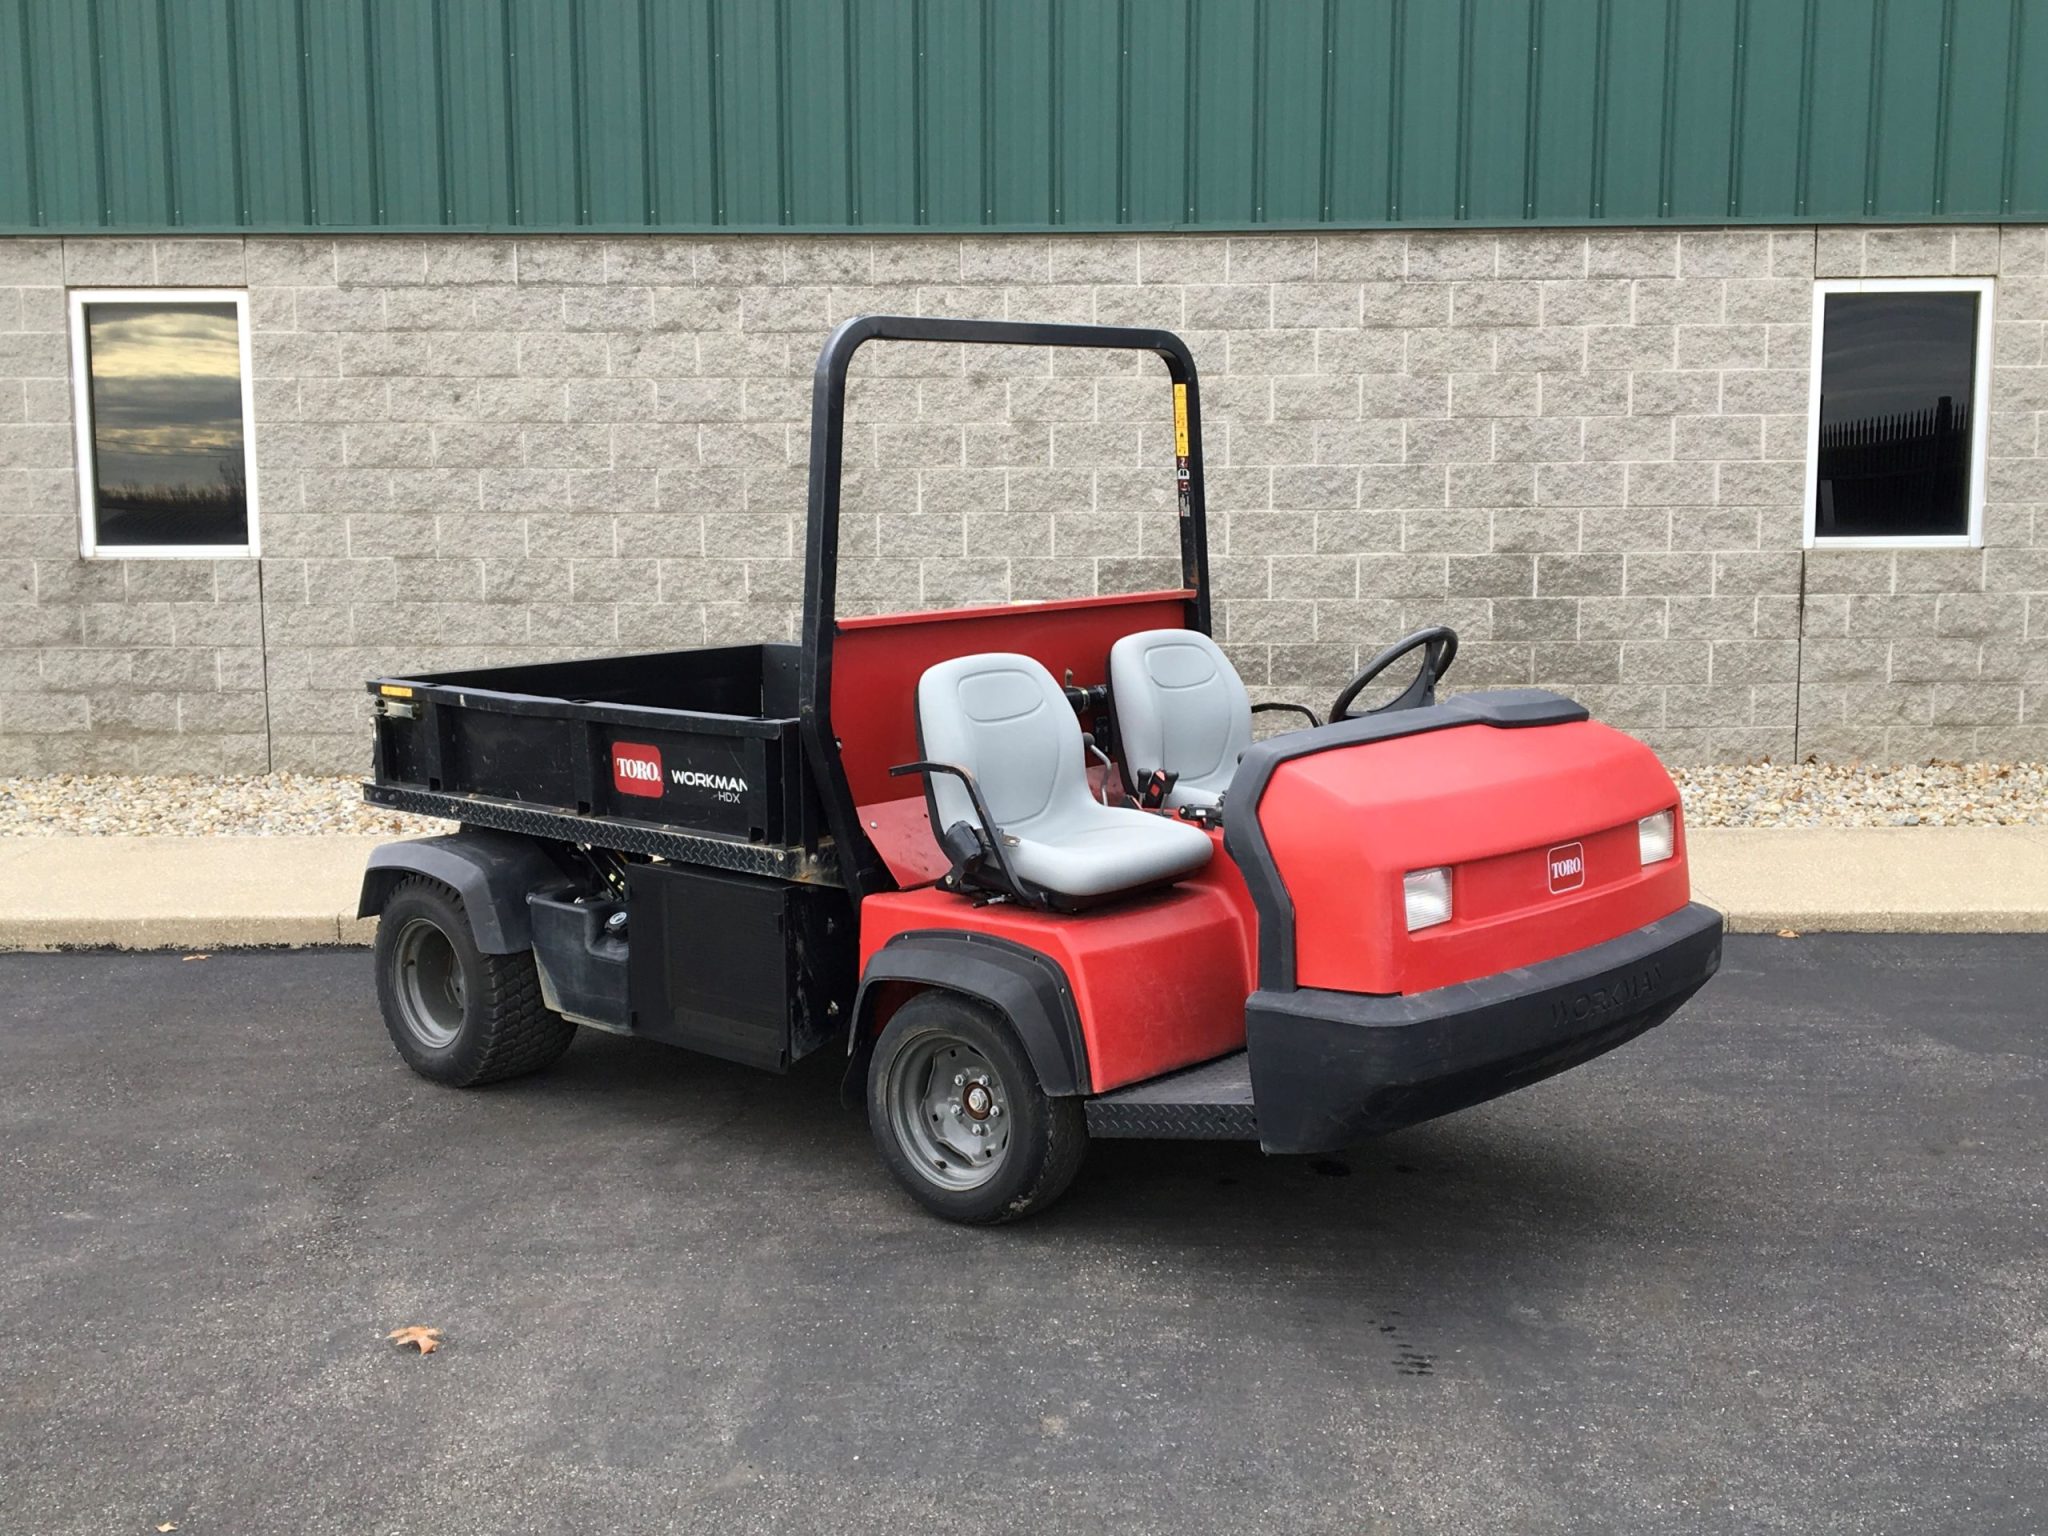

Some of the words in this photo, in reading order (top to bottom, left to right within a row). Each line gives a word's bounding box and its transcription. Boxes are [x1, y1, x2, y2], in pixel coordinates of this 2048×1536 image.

[616, 757, 661, 782] TORO
[671, 769, 748, 792] WORKMAN
[718, 791, 740, 804] HDX
[1551, 856, 1581, 879] TORO
